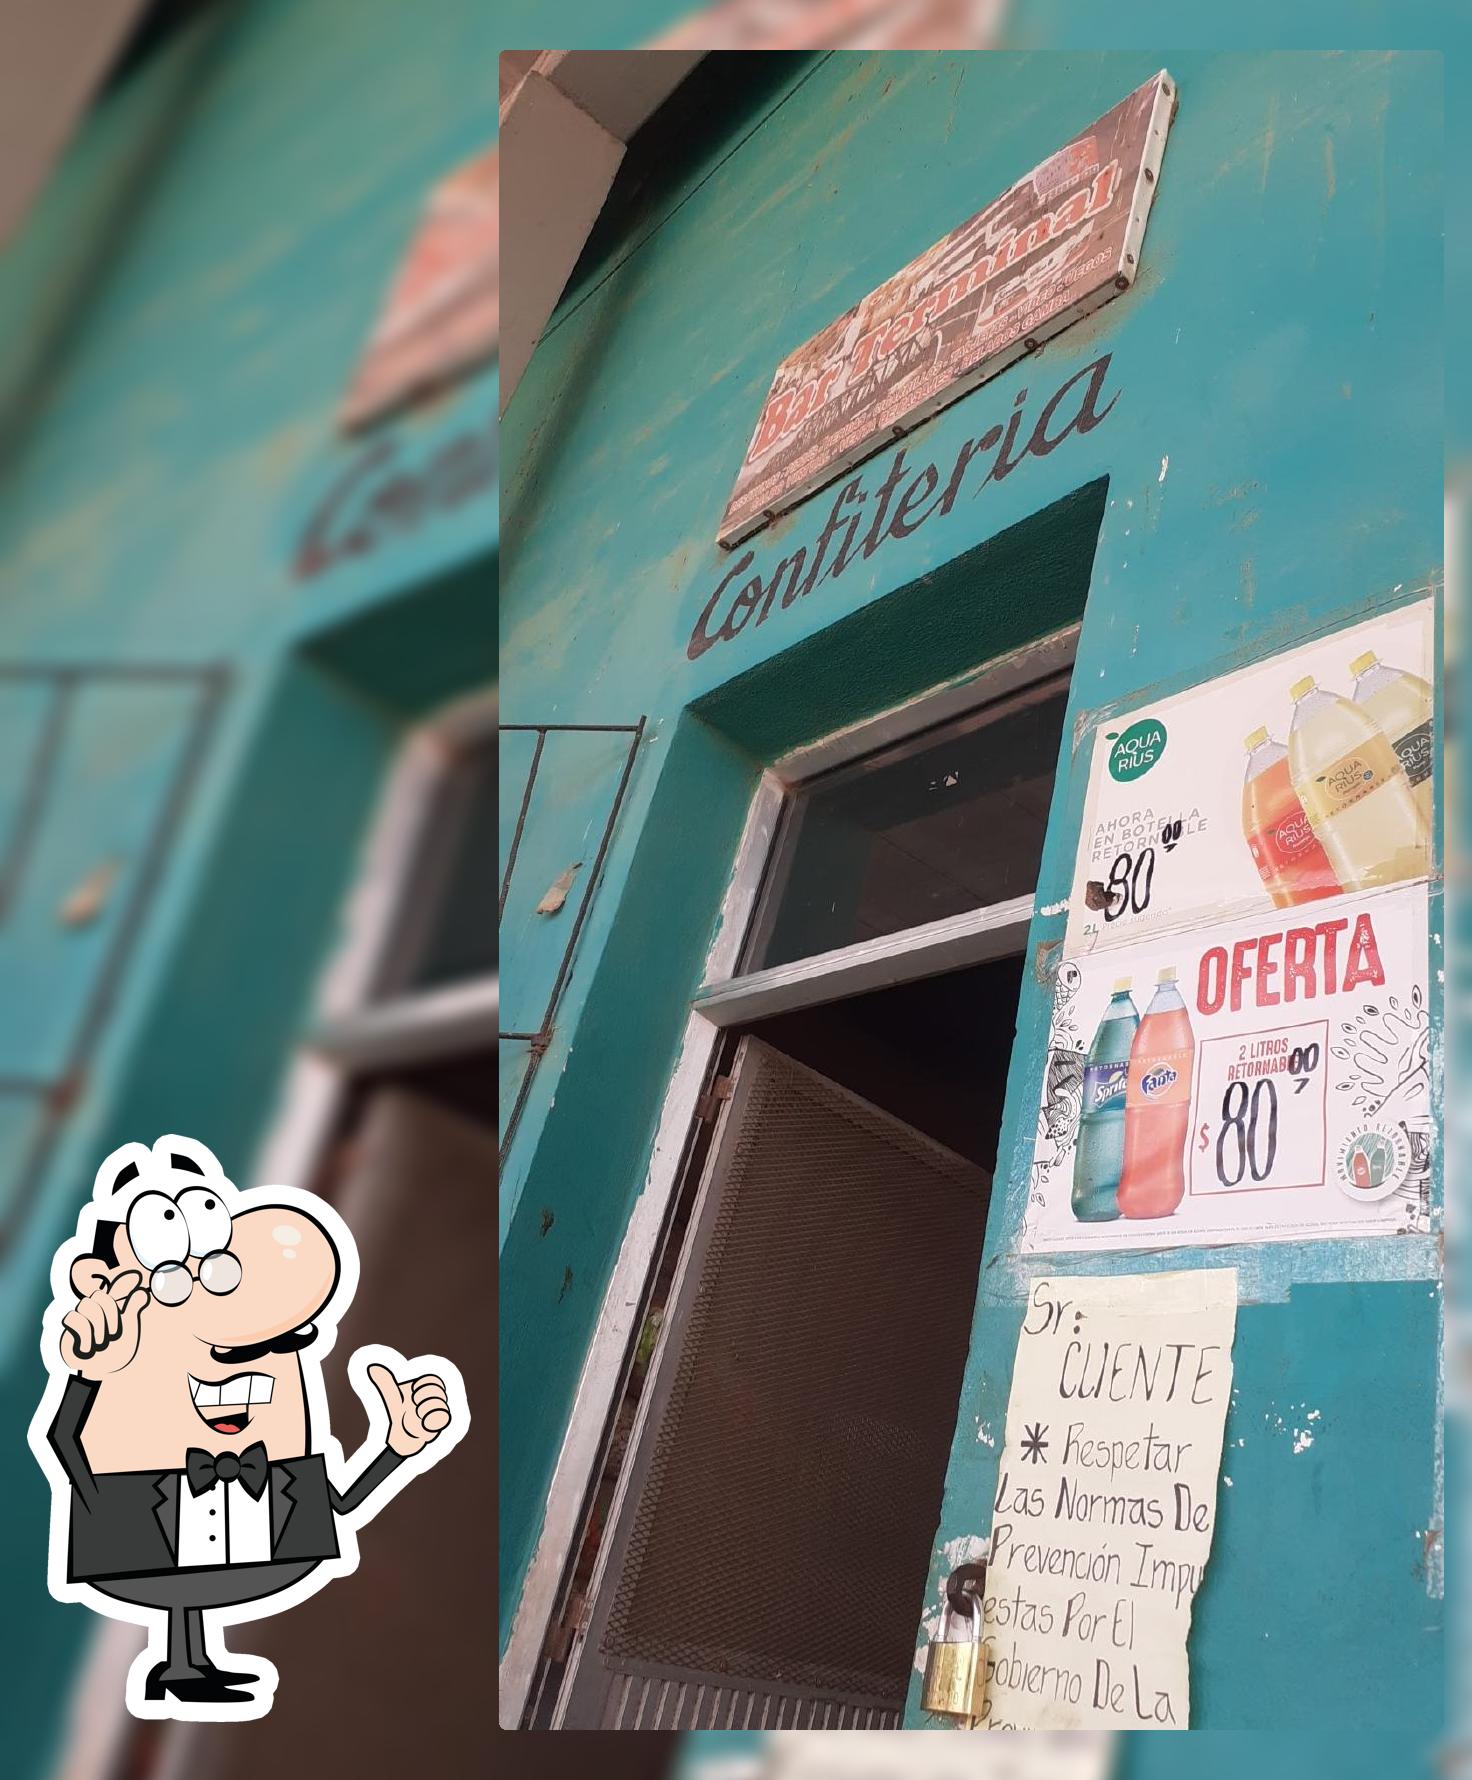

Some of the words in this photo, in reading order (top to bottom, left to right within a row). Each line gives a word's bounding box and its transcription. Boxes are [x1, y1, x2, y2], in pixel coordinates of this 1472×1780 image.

[749, 362, 842, 461] Bar
[849, 160, 1118, 385] Terminal
[687, 353, 1122, 660] Confiteria
[1114, 730, 1161, 758] AQUA
[1118, 749, 1154, 773] RIUS
[1328, 760, 1362, 787] AQUA
[1336, 771, 1361, 793] RIUS
[1092, 818, 1208, 862] RETORNLE
[1094, 833, 1115, 849] EN
[1096, 808, 1154, 836] AHORA
[1286, 824, 1311, 846] RIUS
[1196, 913, 1386, 1016] OFERTA
[1239, 1045, 1247, 1060] 2
[1250, 1037, 1289, 1059] LITROS
[1142, 1069, 1178, 1096] Fanta
[1198, 1122, 1210, 1153] $
[1216, 1078, 1278, 1187] 80
[1289, 1043, 1320, 1075] 00
[1024, 1282, 1082, 1334] Sr:
[1059, 1341, 1220, 1404] CLIENTE
[1063, 1422, 1192, 1482] Respetar
[994, 1473, 1044, 1517] Las
[1055, 1476, 1163, 1529] Normas
[1174, 1483, 1209, 1532] De
[988, 1524, 1121, 1584] Prevención
[1130, 1542, 1203, 1609] Impu
[984, 1586, 1053, 1634] estas
[1062, 1592, 1106, 1642] Por
[1112, 1599, 1134, 1649] El
[1094, 1659, 1124, 1712] De
[1134, 1665, 1176, 1724] La
